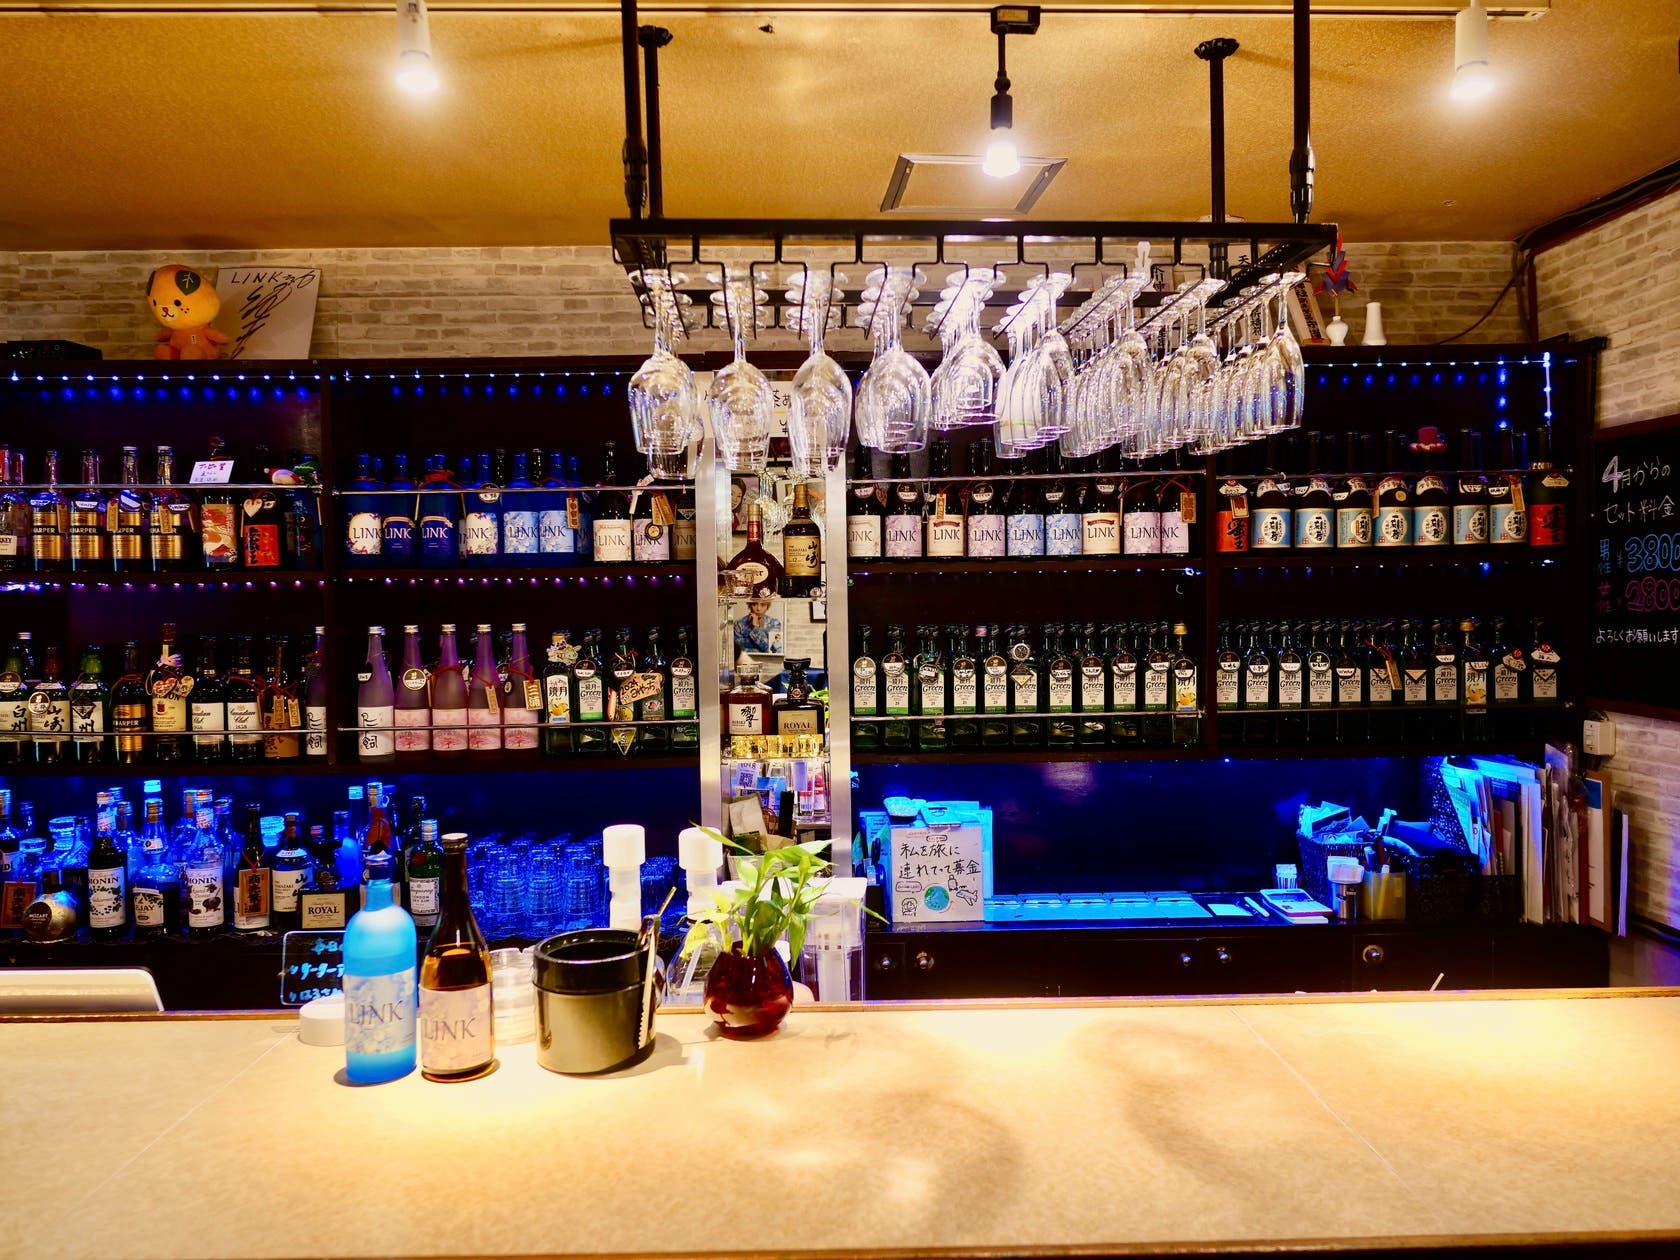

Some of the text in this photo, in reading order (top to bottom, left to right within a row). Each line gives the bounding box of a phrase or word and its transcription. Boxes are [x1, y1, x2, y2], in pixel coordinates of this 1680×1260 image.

[1602, 455, 1671, 493] 4月からの
[1604, 495, 1675, 524] セット料金
[353, 527, 382, 539] LINK
[385, 527, 411, 539] LINK
[421, 527, 448, 539] LINK
[509, 526, 539, 539] LINK
[888, 530, 917, 542] LINK
[933, 529, 961, 541] LINK
[973, 530, 1002, 542] LINK
[1014, 529, 1042, 541] LINK
[1053, 528, 1081, 541] LINK
[1087, 527, 1115, 539] LINK
[1131, 527, 1159, 539] LINK
[598, 535, 625, 546] LINK
[1595, 628, 1680, 644] よろしくお願いします
[1083, 682, 1104, 690] Green
[1114, 681, 1136, 689] Green
[1216, 679, 1238, 687] Green
[1247, 679, 1268, 687] Green
[1280, 680, 1301, 688] Green
[1310, 679, 1331, 687] Green
[1339, 679, 1361, 687] Green
[1435, 677, 1456, 685] Green
[1495, 676, 1517, 684] Green
[620, 679, 639, 695] 2024
[673, 687, 694, 695] Green
[954, 684, 976, 692] Green
[985, 684, 1006, 692] Green
[581, 690, 602, 698] Green
[11, 704, 28, 732] 白州
[783, 721, 813, 730] ROYAL
[900, 842, 961, 860] 私を旅に
[308, 906, 340, 915] ROYAL
[311, 938, 344, 955] 本日
[349, 1000, 404, 1025] LINK
[423, 1017, 476, 1041] LINK
